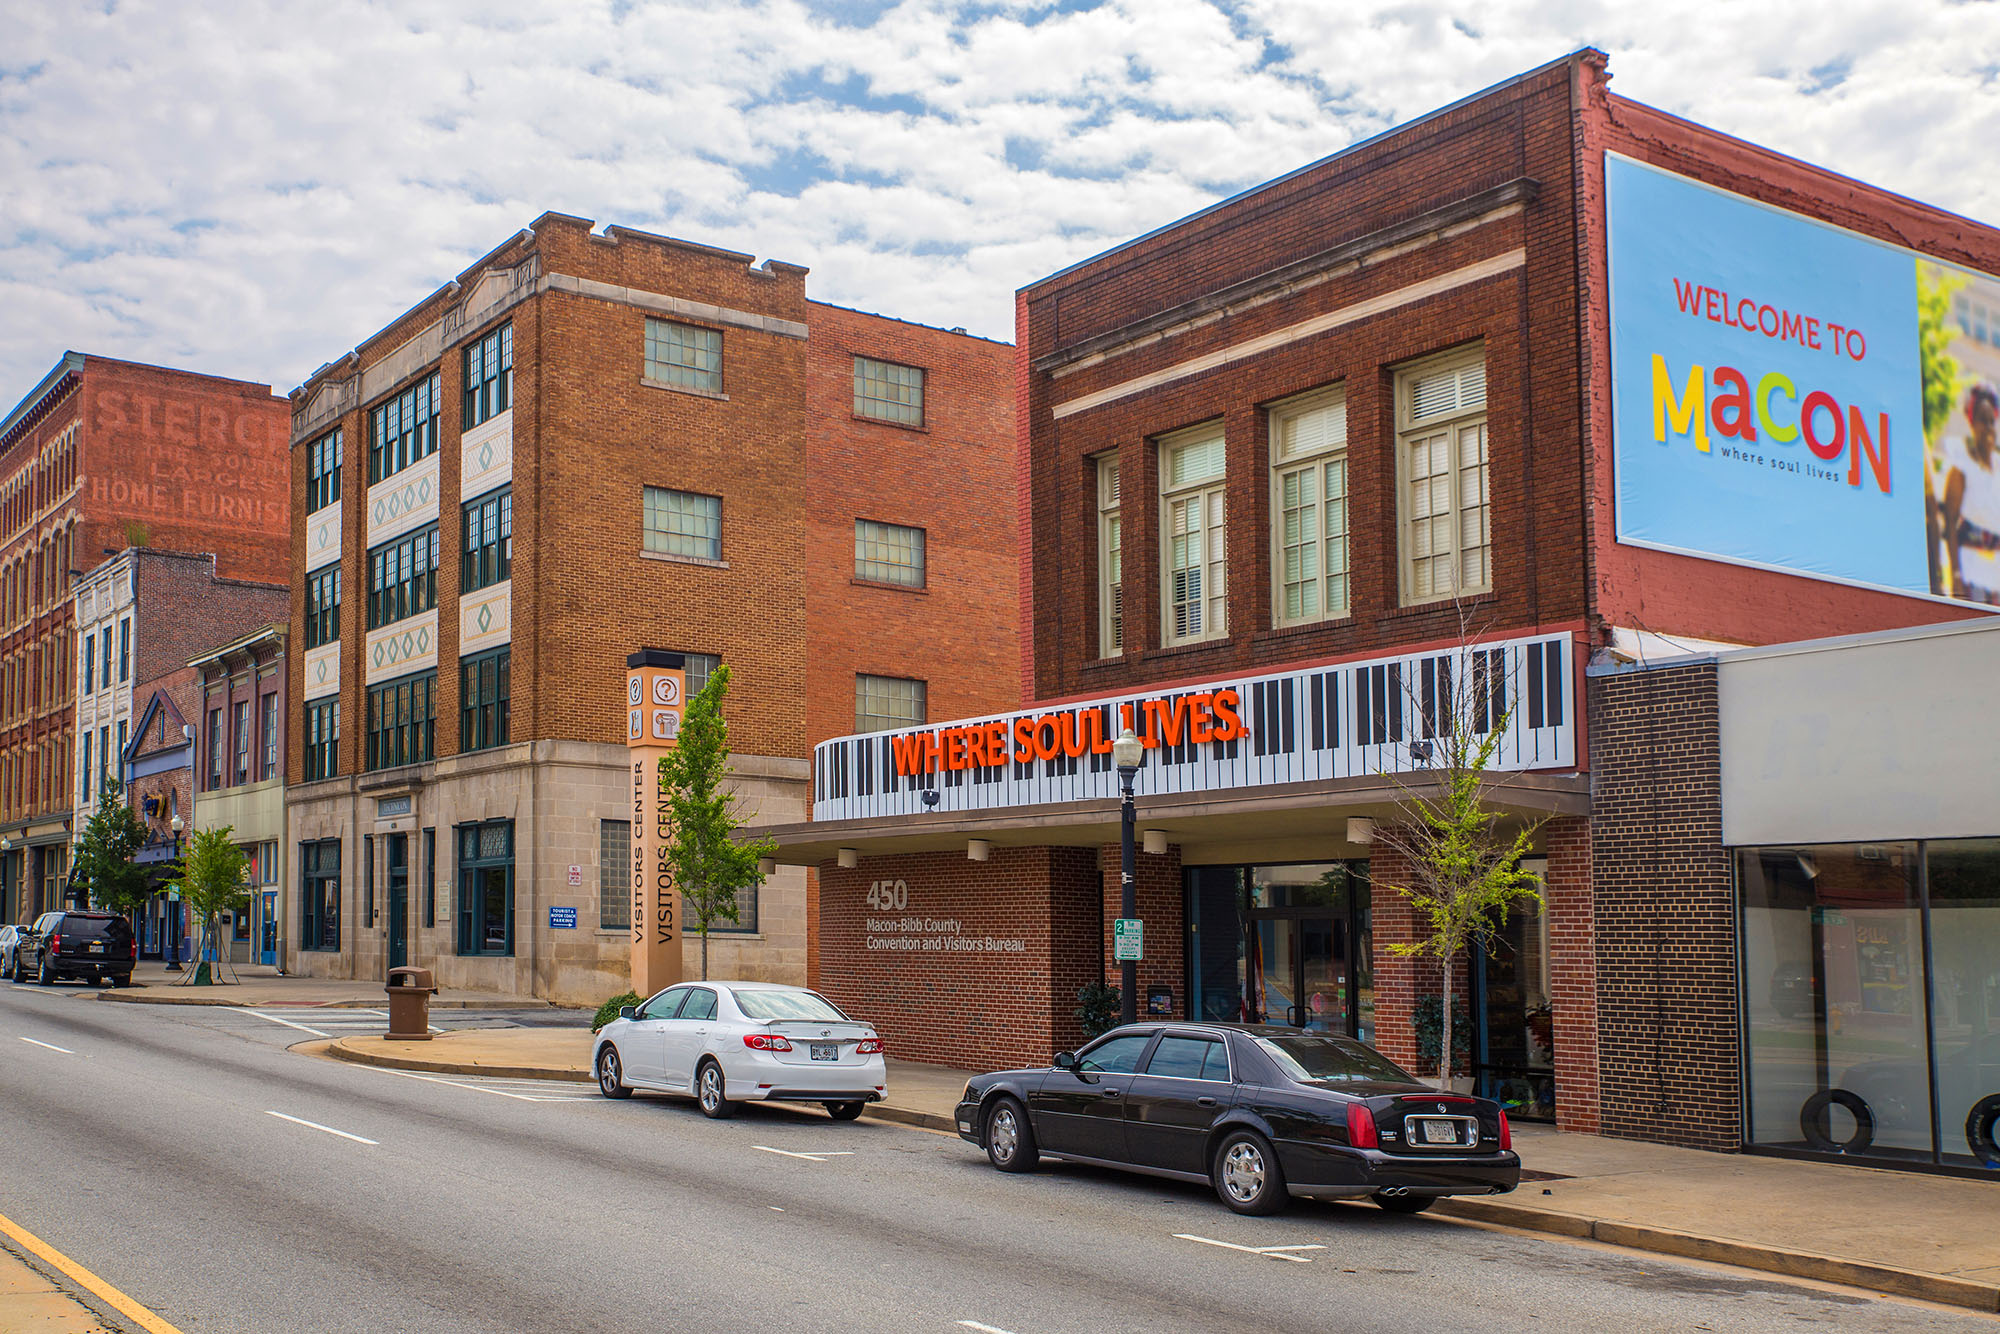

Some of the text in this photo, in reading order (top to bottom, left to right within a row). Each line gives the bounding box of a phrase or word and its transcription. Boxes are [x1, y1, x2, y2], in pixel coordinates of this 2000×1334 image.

[1673, 277, 1866, 361] WELCOME TO
[1720, 446, 1839, 482] where soul lives
[91, 476, 167, 510] HOME
[892, 722, 1010, 776] WHERE
[1014, 708, 1114, 763] SOUL
[634, 759, 643, 944] VISITORS CENTER
[866, 879, 908, 911] 450
[866, 917, 962, 936] Macon-Bibb County
[866, 935, 1025, 952] Convention and Visitors Bureau
[1117, 923, 1122, 932] 2
